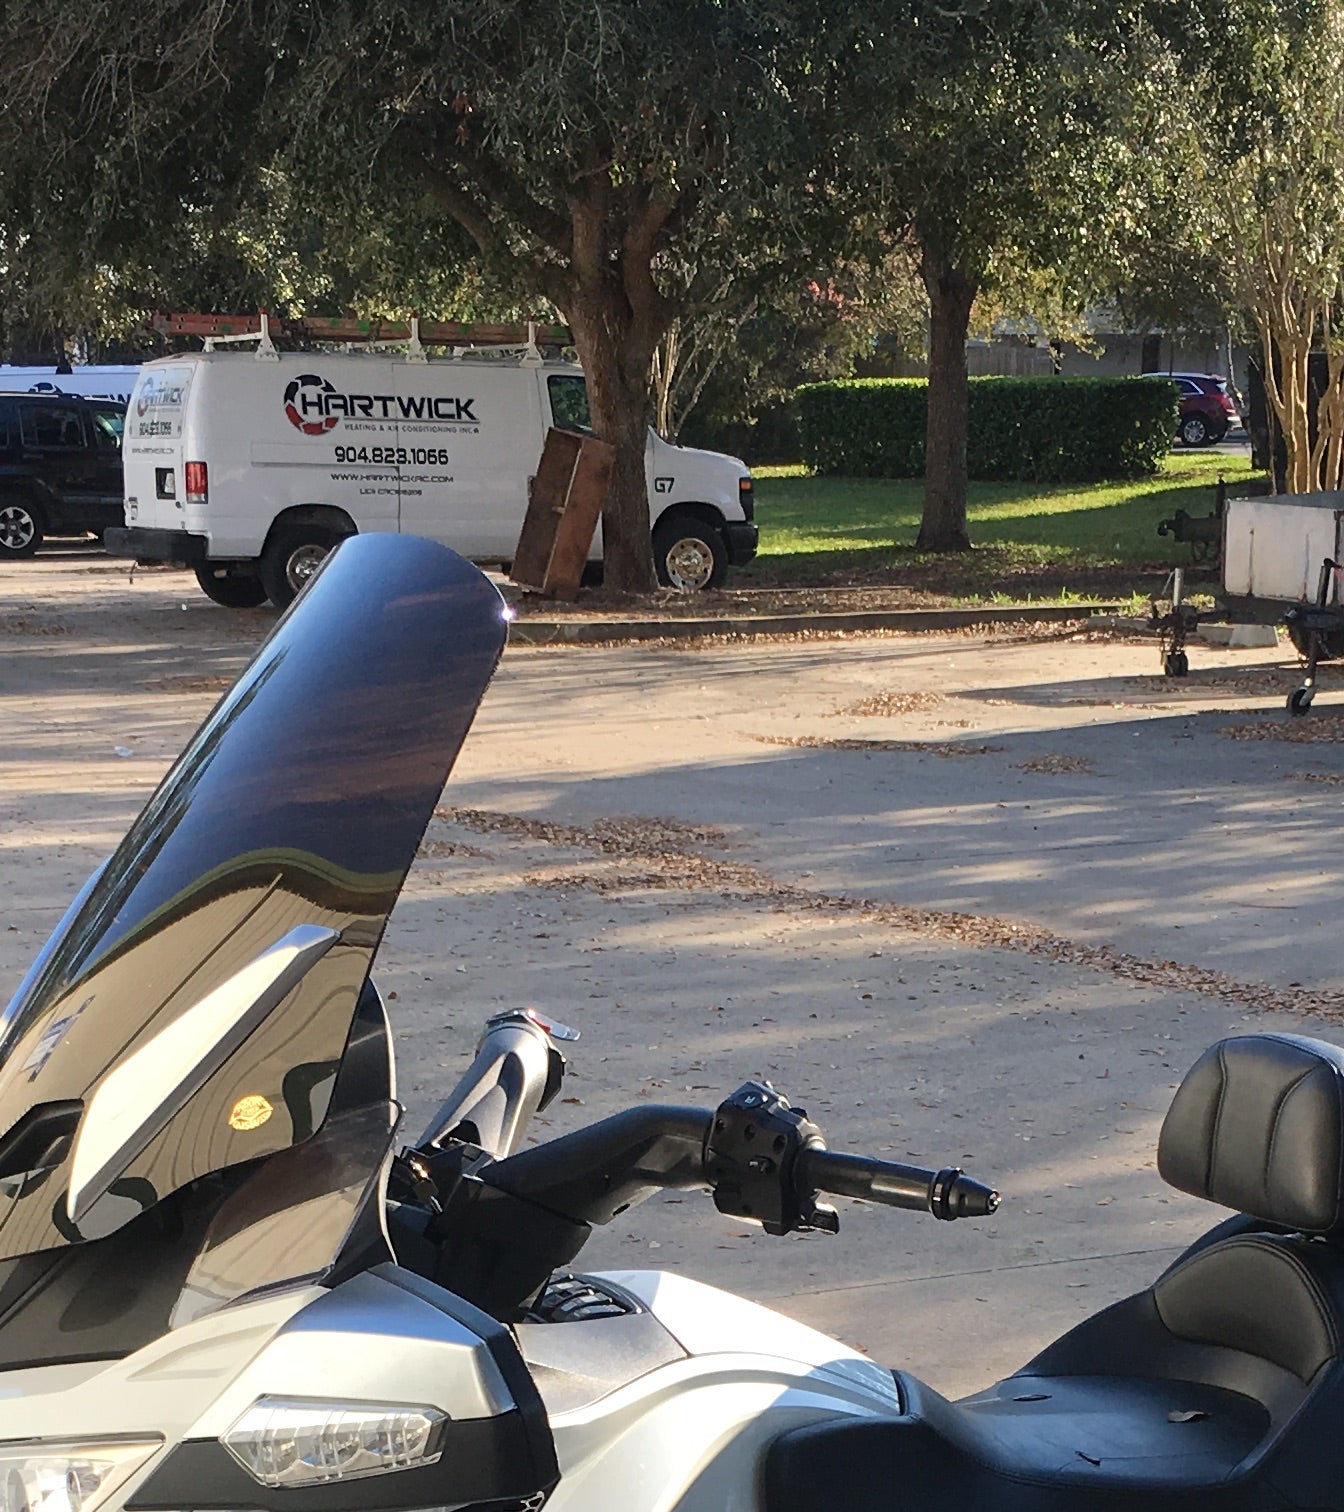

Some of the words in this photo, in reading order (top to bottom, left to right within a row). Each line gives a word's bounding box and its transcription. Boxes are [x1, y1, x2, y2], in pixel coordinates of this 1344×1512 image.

[300, 393, 477, 421] HARTWICK
[344, 424, 376, 432] HEATING
[334, 446, 449, 465] 904.823.1066
[654, 476, 675, 493] G7
